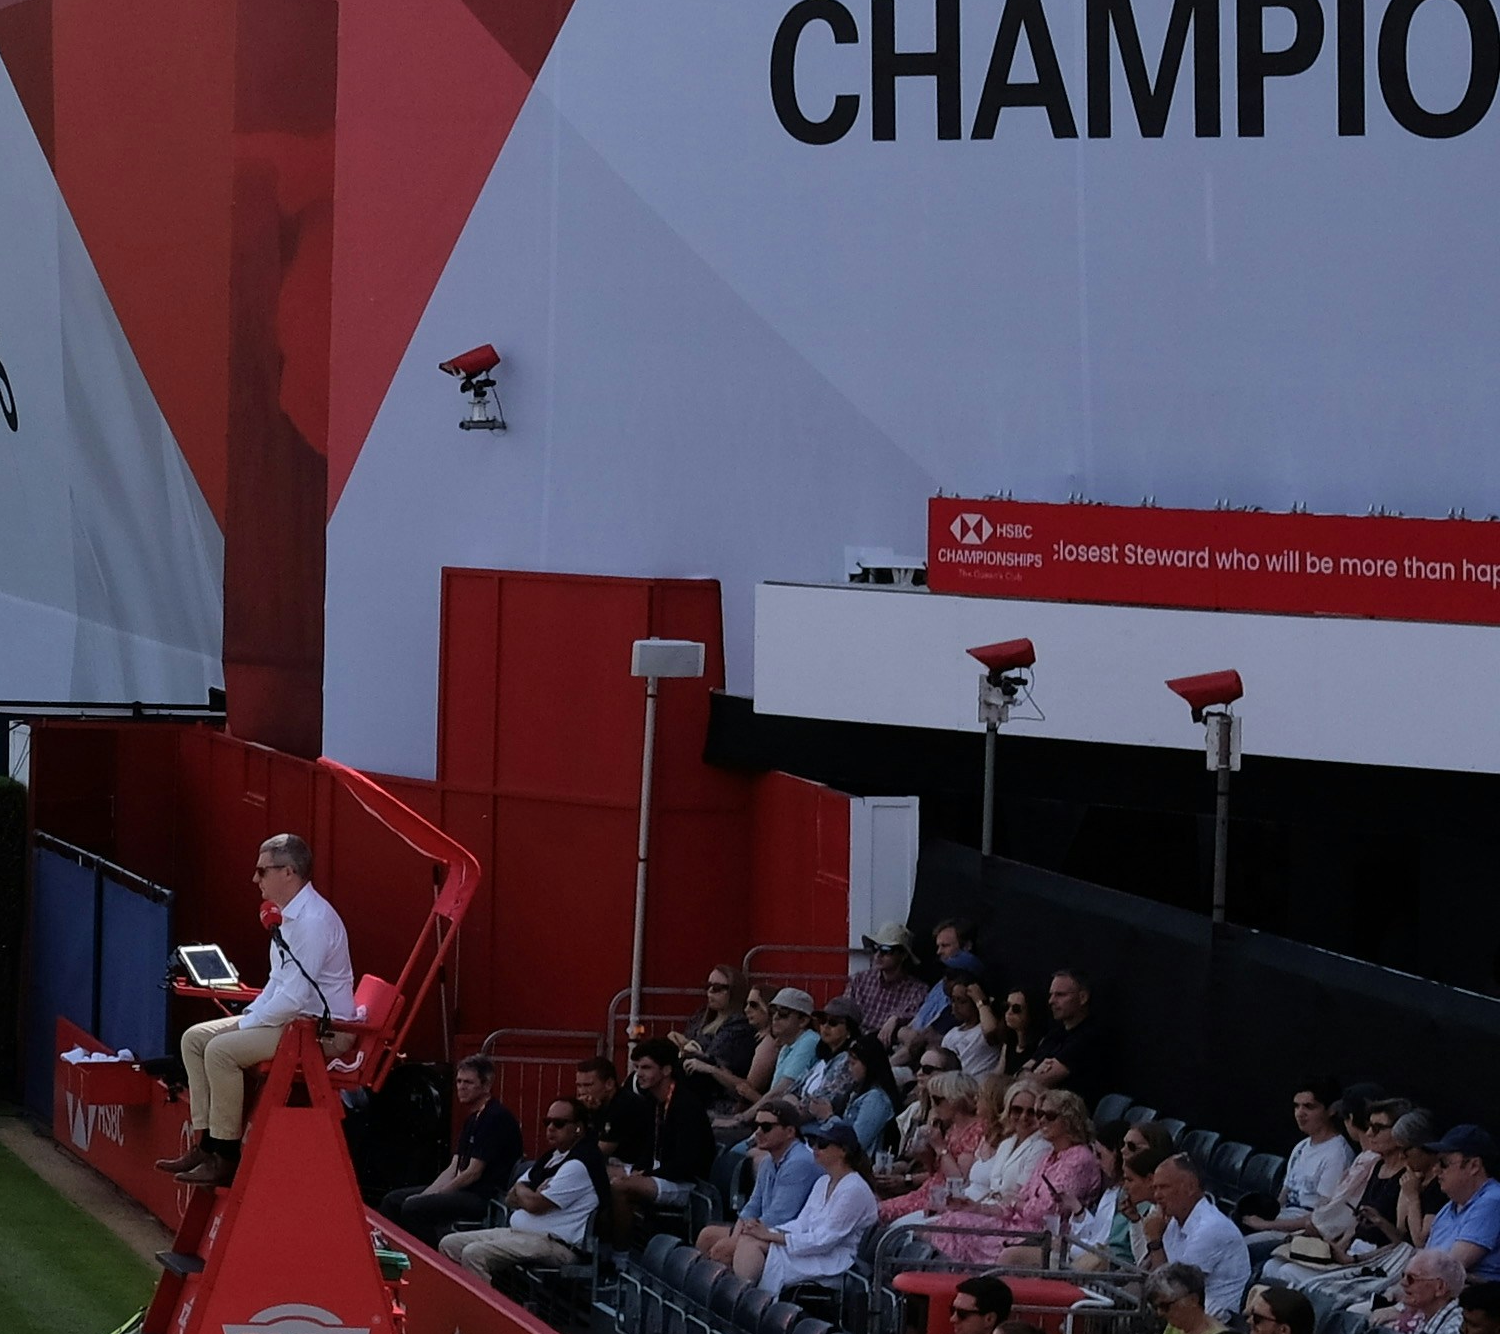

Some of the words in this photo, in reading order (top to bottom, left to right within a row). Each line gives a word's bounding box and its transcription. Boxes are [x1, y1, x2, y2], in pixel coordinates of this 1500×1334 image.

[996, 524, 1033, 539] HSBC
[938, 548, 1043, 568] CHAMPIONSHIPS
[1124, 543, 1209, 569] Steward
[1216, 548, 1260, 571] who
[1266, 550, 1300, 573] will
[1306, 552, 1333, 575] be
[1340, 557, 1398, 578] more
[1403, 557, 1456, 581] than
